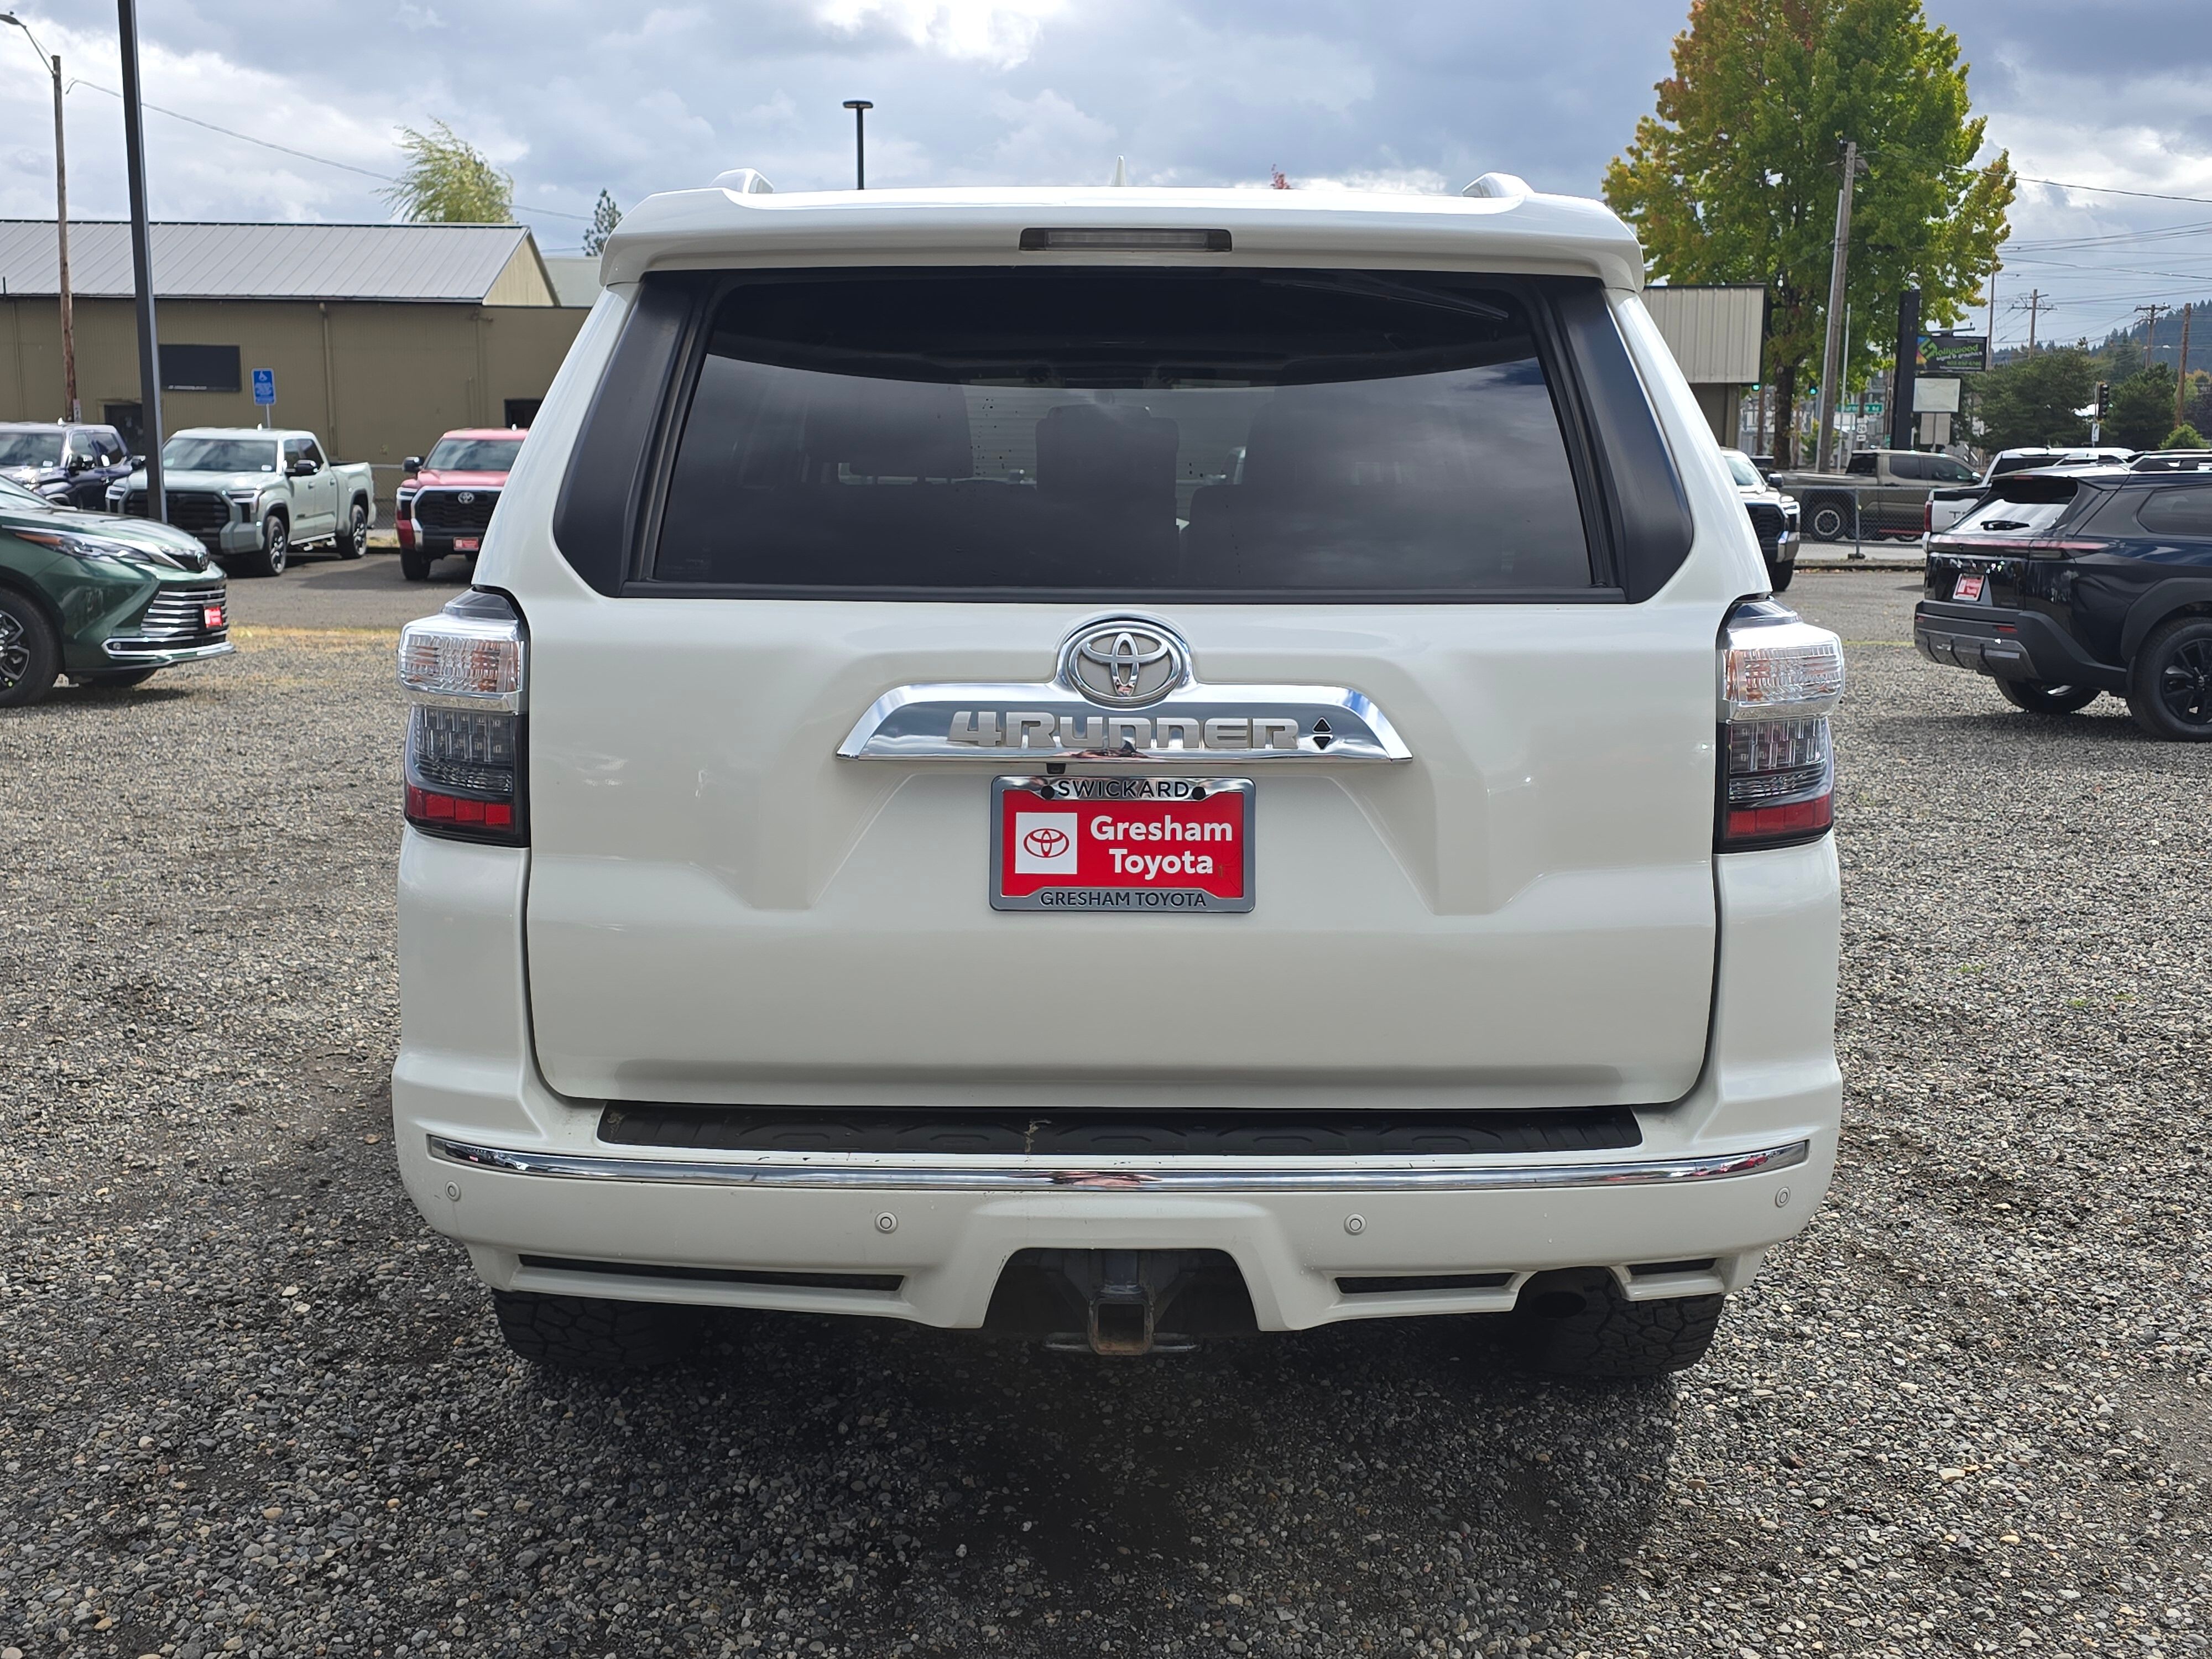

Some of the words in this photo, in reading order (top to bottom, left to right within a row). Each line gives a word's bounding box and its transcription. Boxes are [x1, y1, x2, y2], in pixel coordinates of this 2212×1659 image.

[1058, 780, 1190, 798] SWICKARD
[1090, 815, 1233, 841] Gresham
[1108, 848, 1213, 880] Toyota
[1040, 891, 1130, 906] GRESHAM
[1135, 893, 1207, 907] TOYOTA
